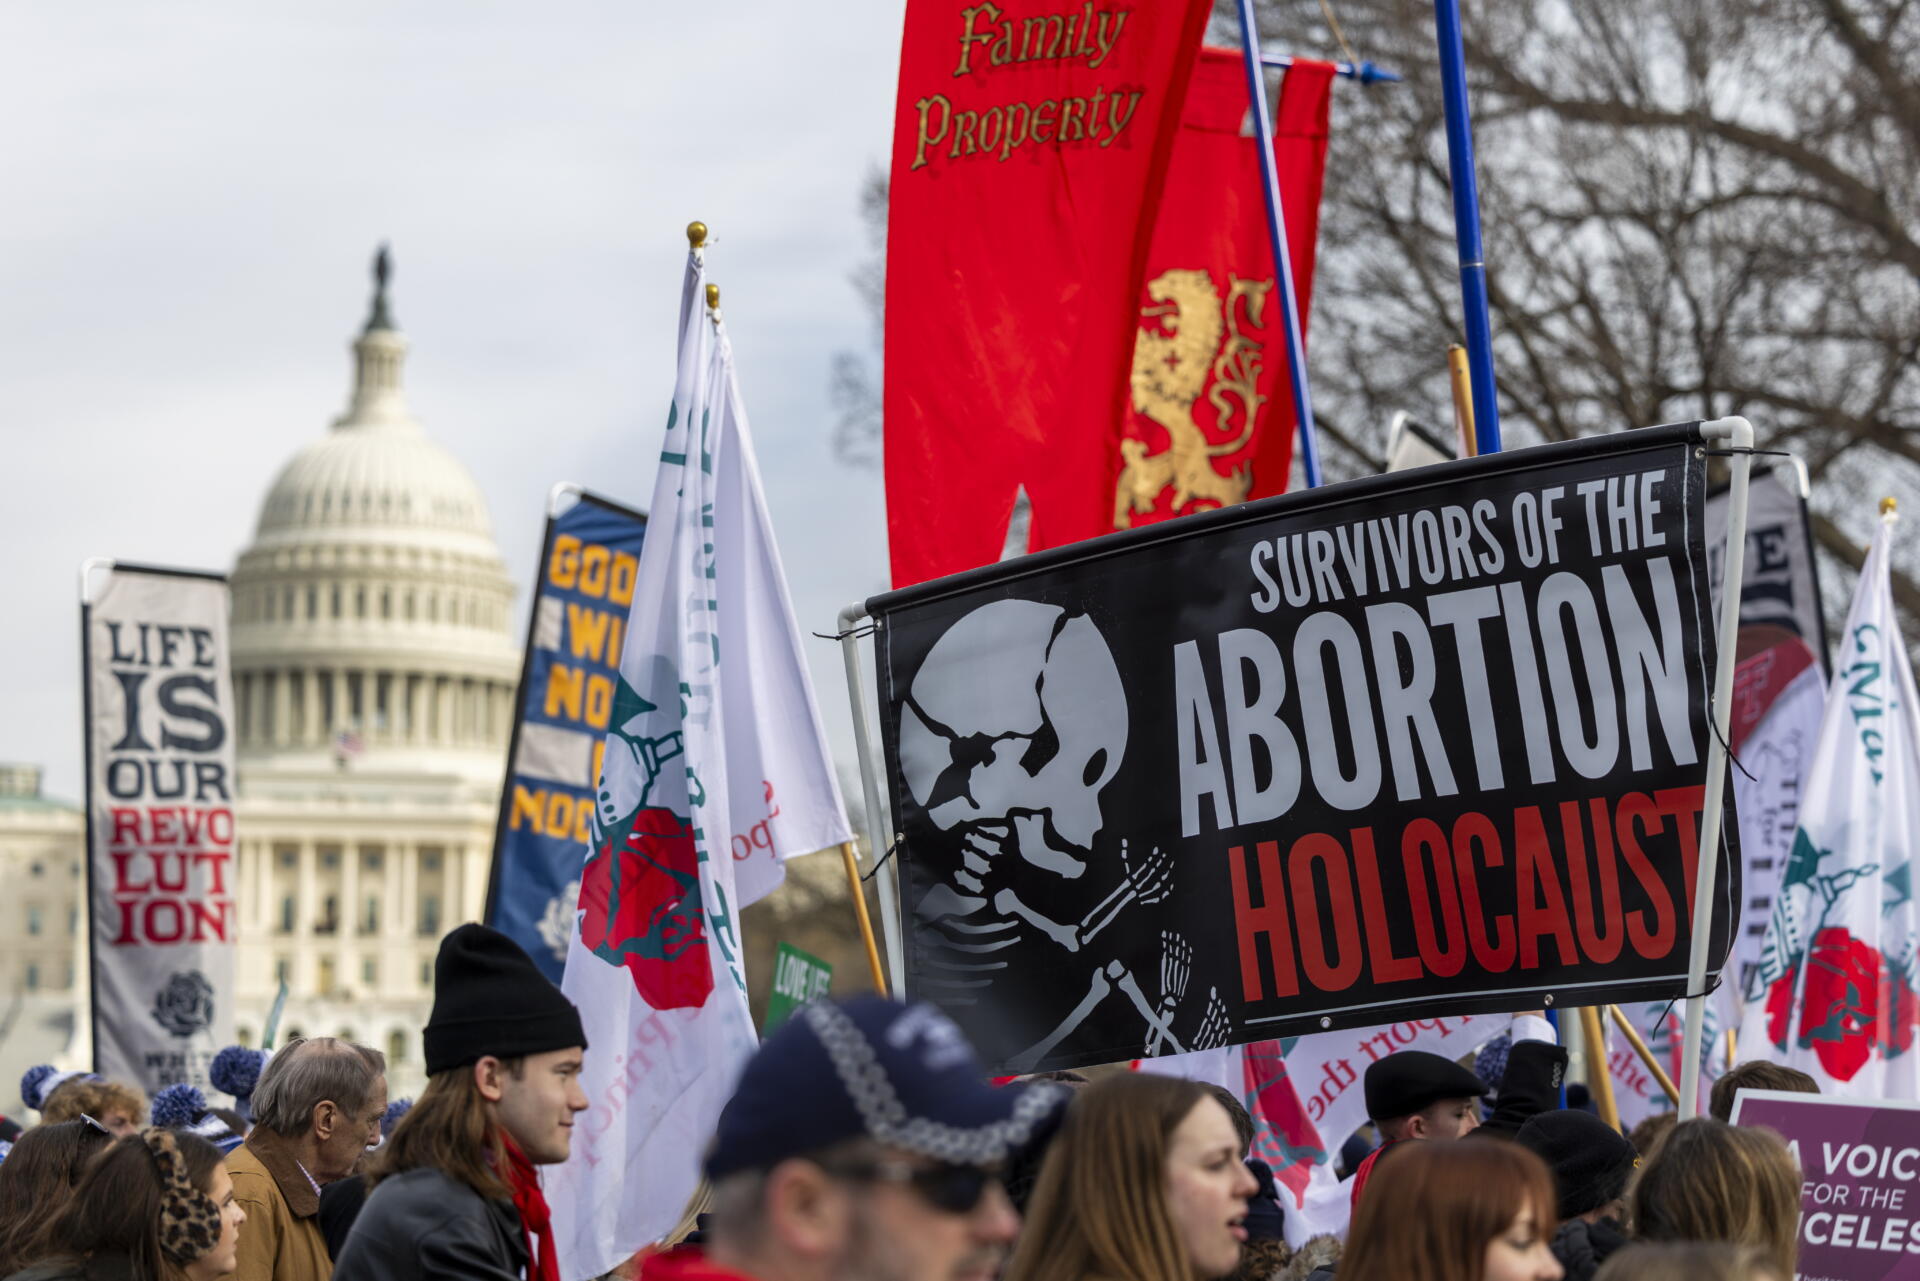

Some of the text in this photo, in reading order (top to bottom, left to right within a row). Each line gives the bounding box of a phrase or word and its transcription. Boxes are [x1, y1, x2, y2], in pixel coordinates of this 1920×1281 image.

[953, 1, 1131, 77] Family
[549, 533, 639, 607] GOD
[1250, 470, 1666, 613] SURVIVORS OF THE
[105, 621, 215, 668] LIFE
[567, 603, 627, 669] WI
[111, 671, 225, 754] IS
[544, 663, 616, 729] NO
[1174, 556, 1700, 838] ABORTION
[106, 758, 231, 803] OUR
[108, 807, 234, 847] REVO
[113, 851, 231, 895] LUT
[1228, 784, 1707, 1002] HOLOCAUST
[1822, 1142, 1920, 1182] VOIC
[1800, 1182, 1906, 1210] FOR THE
